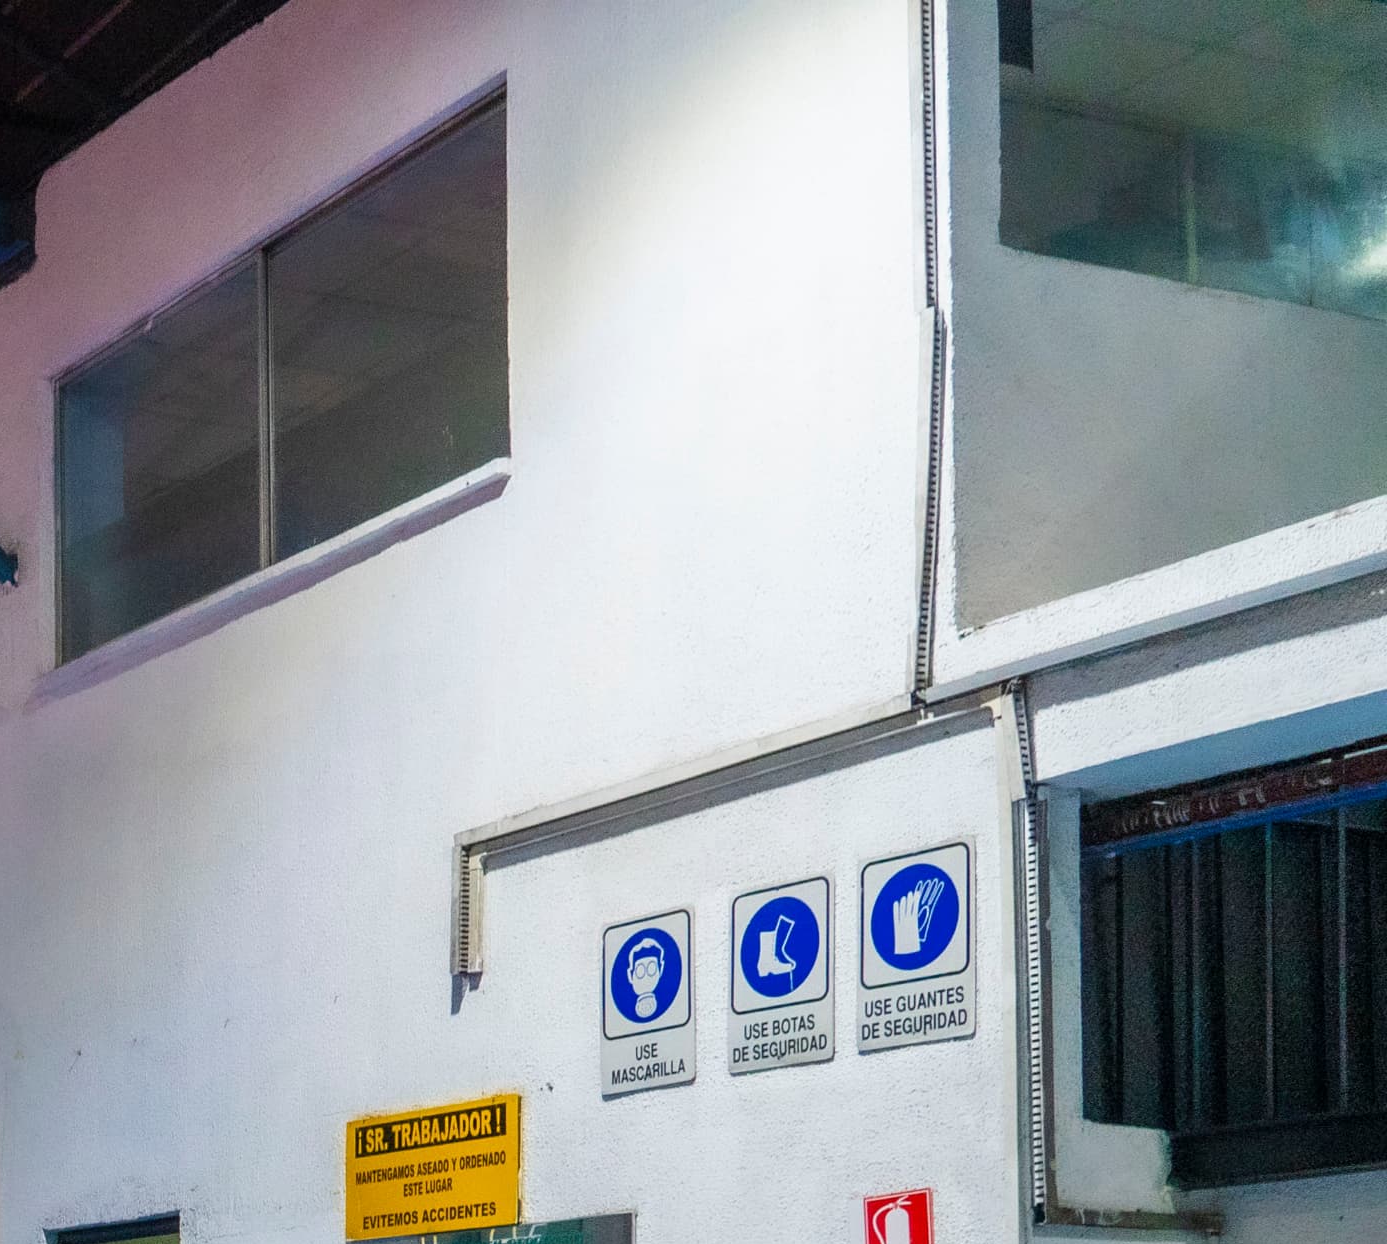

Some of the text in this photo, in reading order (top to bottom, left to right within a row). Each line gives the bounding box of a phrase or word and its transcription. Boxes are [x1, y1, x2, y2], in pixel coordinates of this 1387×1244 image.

[865, 986, 965, 1018] USE GUANTES
[744, 1014, 815, 1040] USE BOTAS
[862, 1009, 968, 1041] DE SEGURIDAD
[635, 1043, 658, 1061] USE
[733, 1034, 827, 1063] DE SEGURIDAD
[612, 1059, 686, 1085] MASCARILLA
[392, 1110, 491, 1149] TRABAJADOR
[355, 1150, 506, 1186] MANTENGAMOS ASEADO Y ORDENADO
[403, 1178, 453, 1197] ESTE LUGAR
[363, 1201, 496, 1230] EVITEMOS ACCIDENTES
